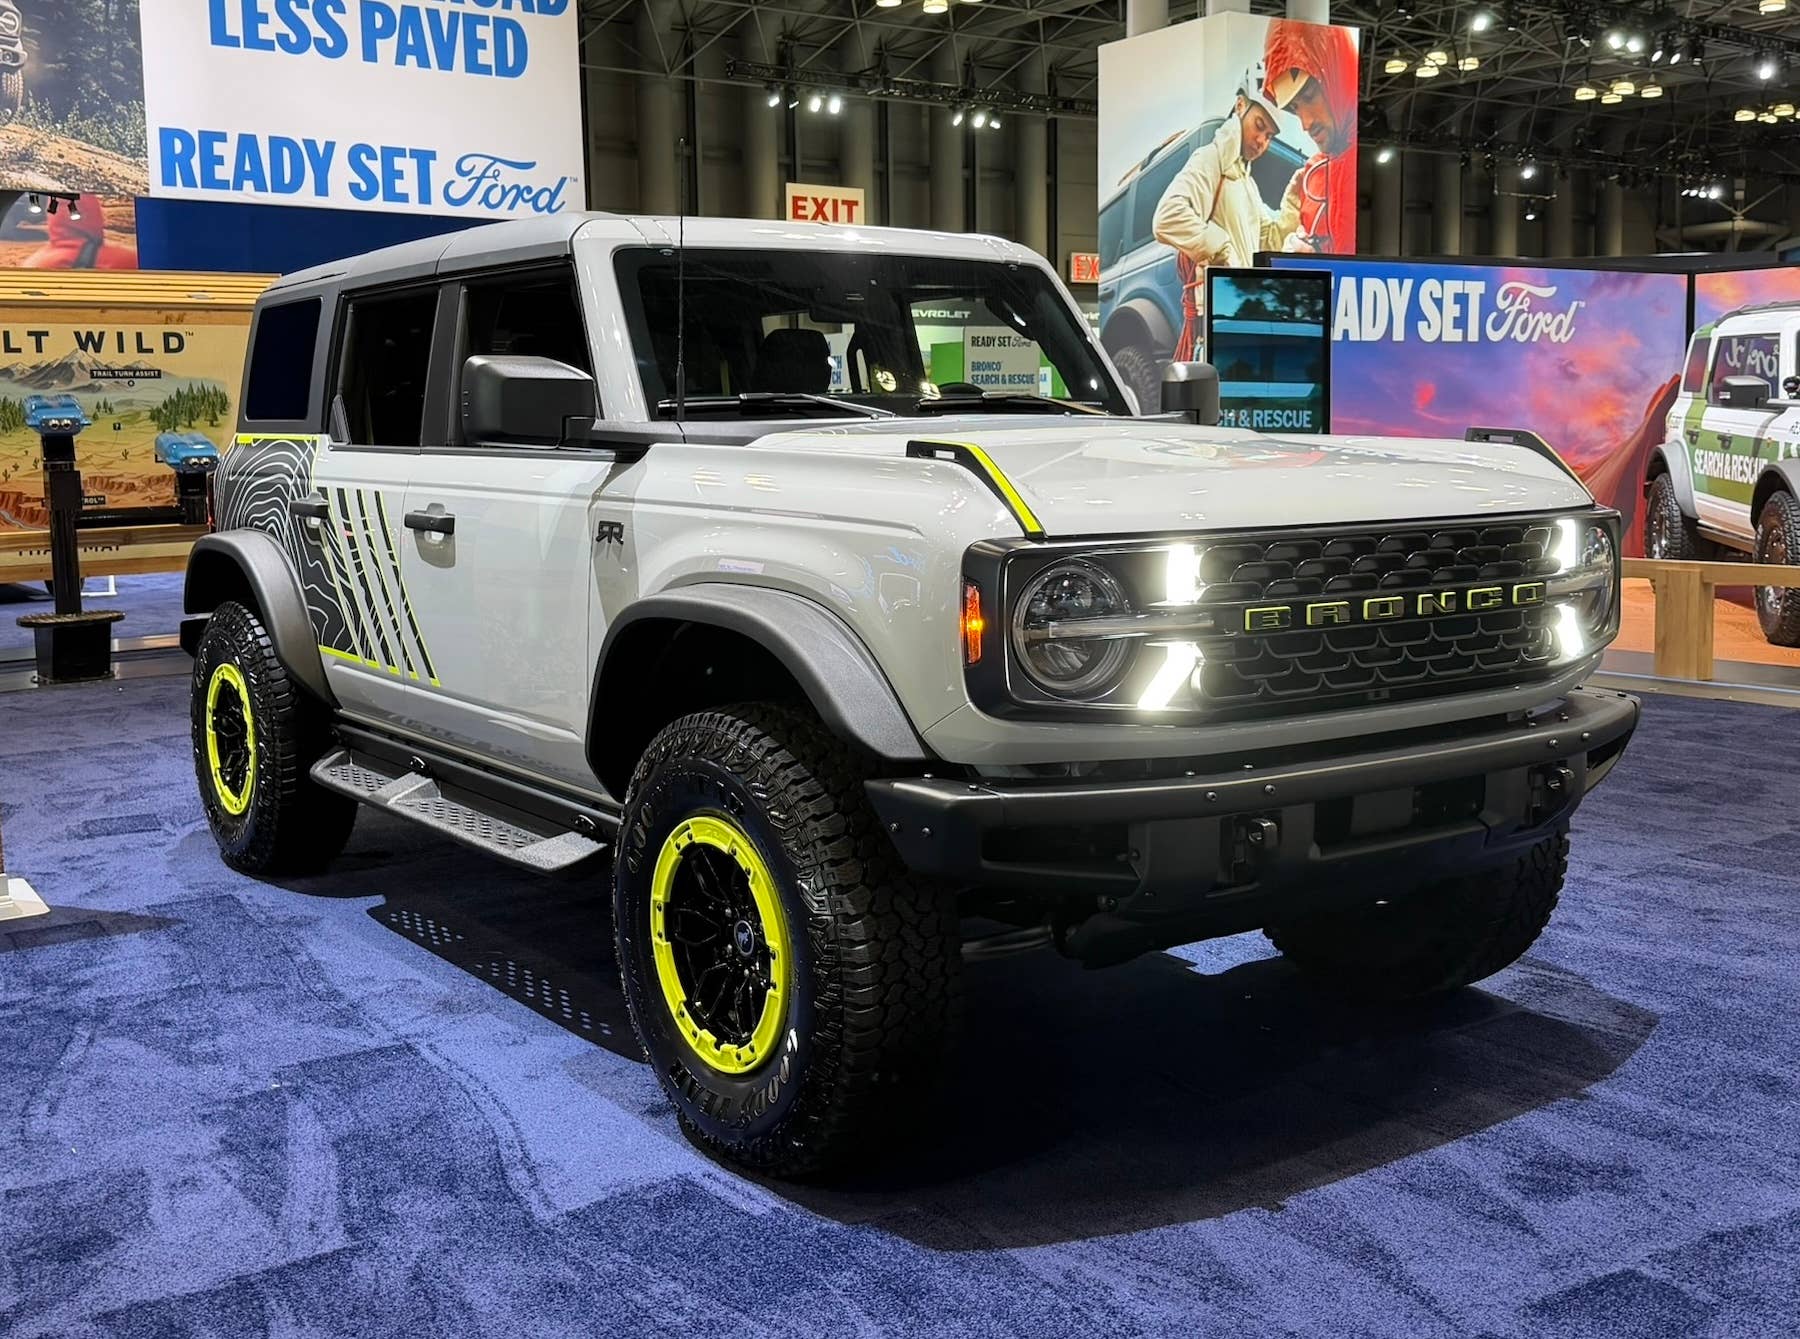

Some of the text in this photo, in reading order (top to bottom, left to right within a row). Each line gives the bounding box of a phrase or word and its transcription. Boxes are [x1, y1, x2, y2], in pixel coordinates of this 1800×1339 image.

[209, 0, 528, 78] LESS PAVED
[159, 127, 336, 197] READY
[347, 143, 437, 205] SET
[791, 195, 859, 224] EXIT
[1331, 276, 1414, 342] ADY
[1417, 279, 1485, 343] SET
[971, 335, 997, 347] READY
[997, 335, 1012, 347] SET
[971, 361, 1001, 372] BRONCO
[971, 374, 1000, 385] SEARCH
[1007, 374, 1035, 385] RESCUE
[1238, 409, 1250, 427] &
[1253, 409, 1312, 428] RESCUE
[1694, 448, 1725, 479] SEARCH
[1724, 453, 1731, 480] &
[1244, 582, 1545, 631] BRONCO
